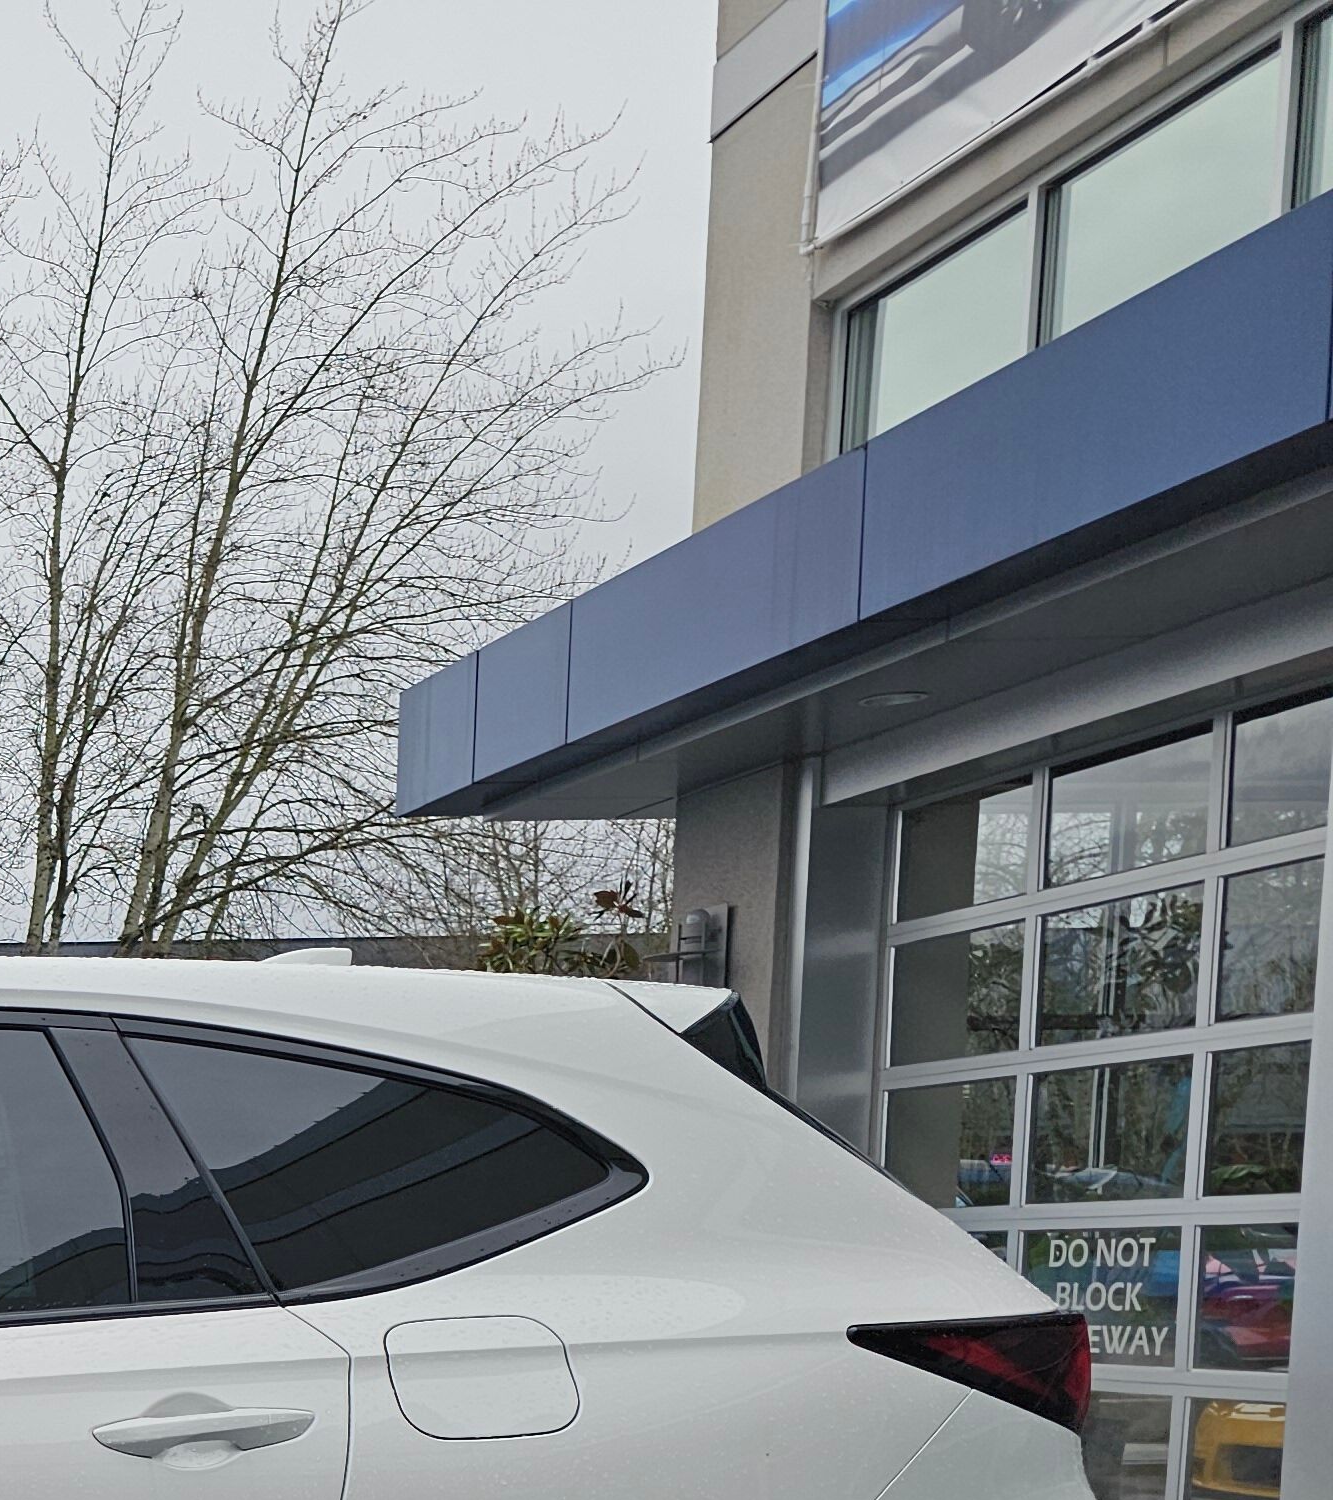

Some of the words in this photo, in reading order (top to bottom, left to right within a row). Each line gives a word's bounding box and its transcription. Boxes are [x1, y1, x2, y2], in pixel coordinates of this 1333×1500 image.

[1048, 1238, 1089, 1268] DO
[1096, 1237, 1157, 1268] NOT
[1055, 1281, 1144, 1312] BLOCK
[1088, 1325, 1169, 1356] EWAY
